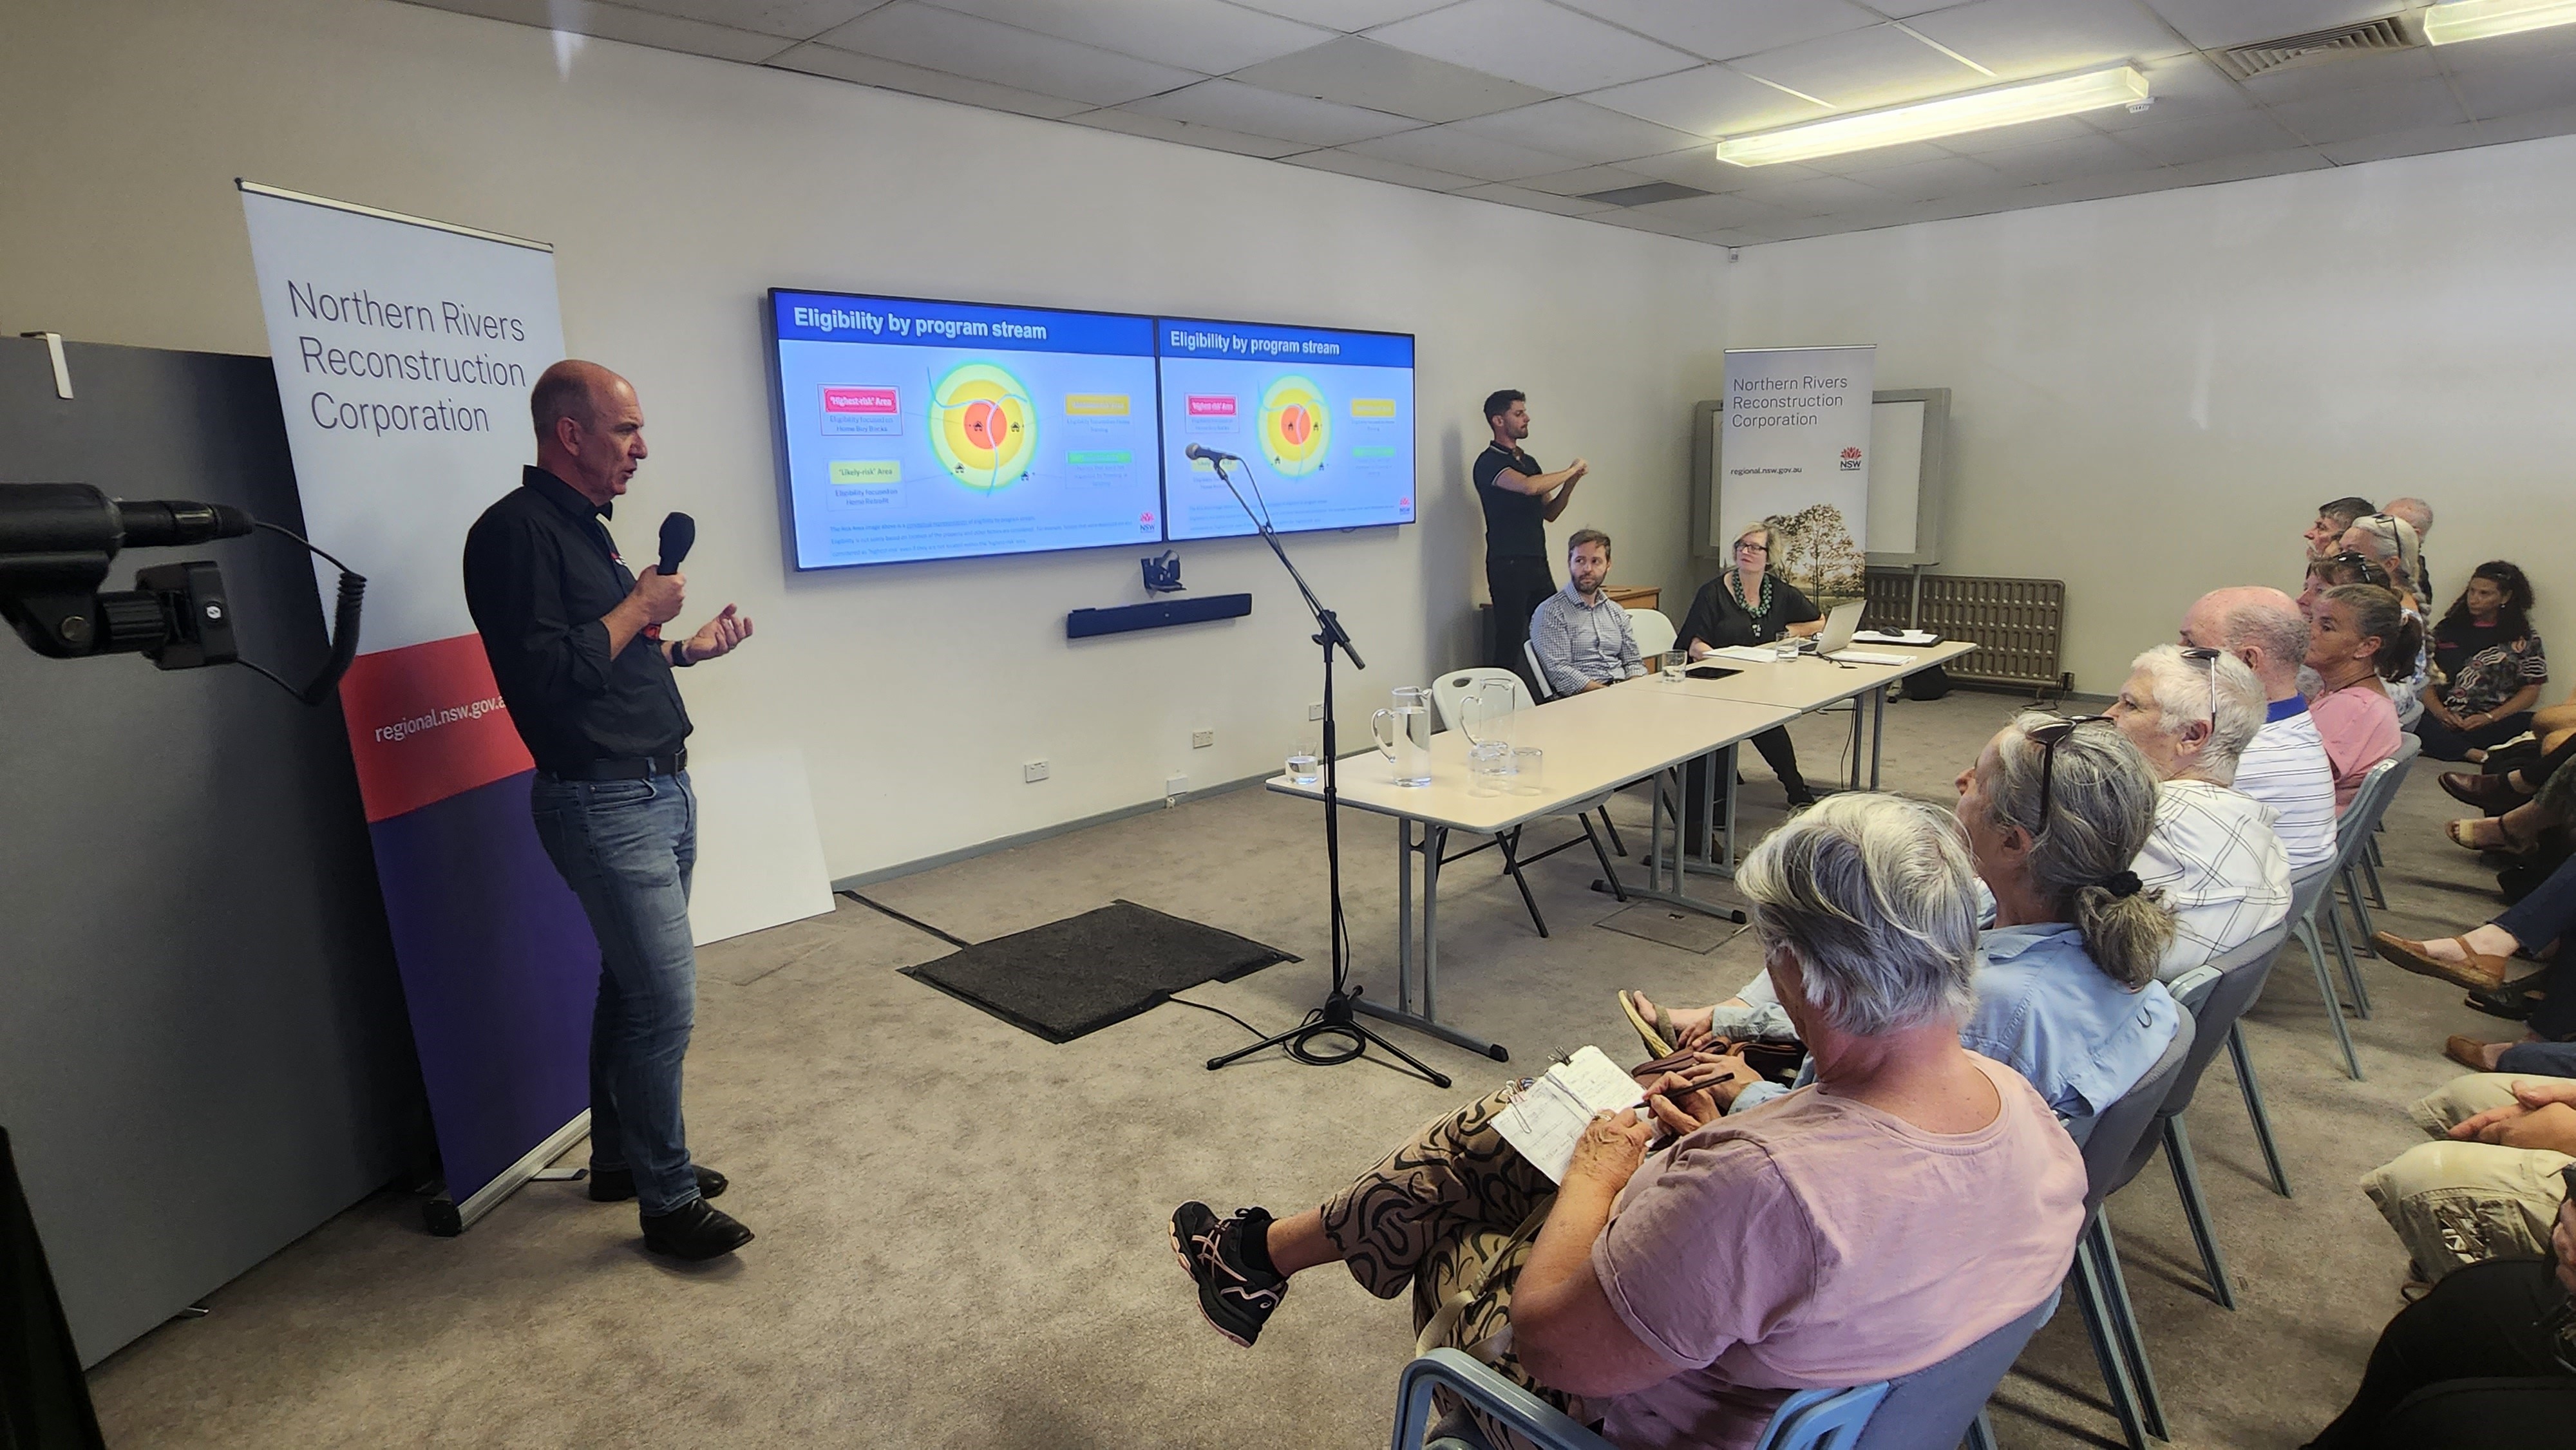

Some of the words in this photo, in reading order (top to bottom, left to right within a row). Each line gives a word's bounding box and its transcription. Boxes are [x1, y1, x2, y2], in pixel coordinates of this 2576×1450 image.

[288, 279, 435, 333] Northern
[442, 301, 525, 342] Rivers
[794, 306, 884, 335] Eligibility
[887, 312, 911, 336] by
[915, 318, 989, 339] program
[992, 321, 1047, 340] stream
[1170, 330, 1230, 352] Eligibility
[1232, 334, 1248, 353] by
[1250, 337, 1300, 355] program
[1302, 339, 1340, 356] stream
[299, 335, 526, 388] Reconstruction
[1734, 377, 1798, 392] Northern
[1803, 375, 1848, 390] Rivers
[311, 391, 489, 438] Corporation
[1733, 393, 1843, 410] Reconstruction
[1732, 413, 1818, 429] Corporation
[1730, 467, 1803, 476] regional.nsw.gov.au
[375, 695, 506, 742] regional.nsw.gov.a
